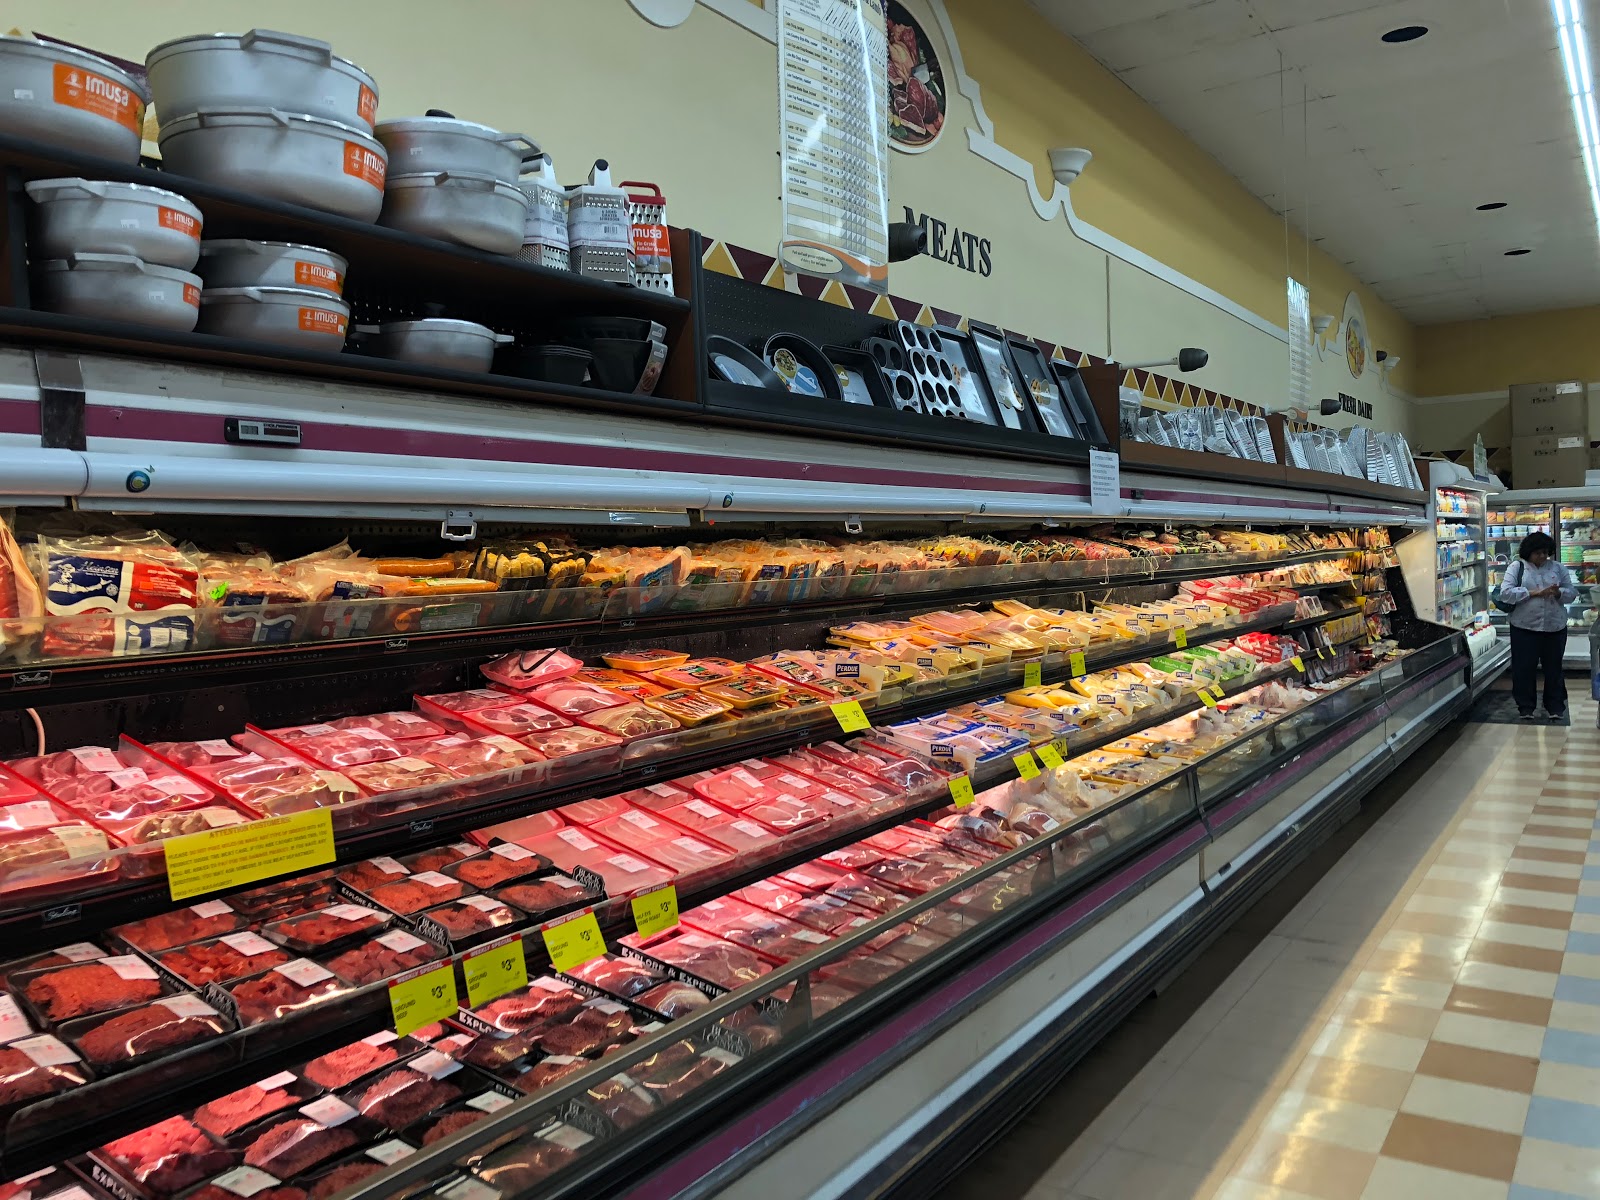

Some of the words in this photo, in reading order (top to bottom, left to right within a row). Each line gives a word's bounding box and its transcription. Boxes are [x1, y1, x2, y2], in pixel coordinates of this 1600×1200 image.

[632, 227, 662, 239] musa
[903, 205, 992, 278] MEATS
[104, 668, 165, 679] UNMATCHED
[171, 664, 211, 673] QUALITY
[837, 664, 858, 672] PERDUE
[932, 745, 952, 753] PERDUE
[208, 825, 248, 838] ATTENTION
[621, 946, 666, 972] EXPLORE
[667, 966, 676, 977] &
[679, 971, 727, 998] EXPERIE
[459, 1011, 495, 1034] EXPLO
